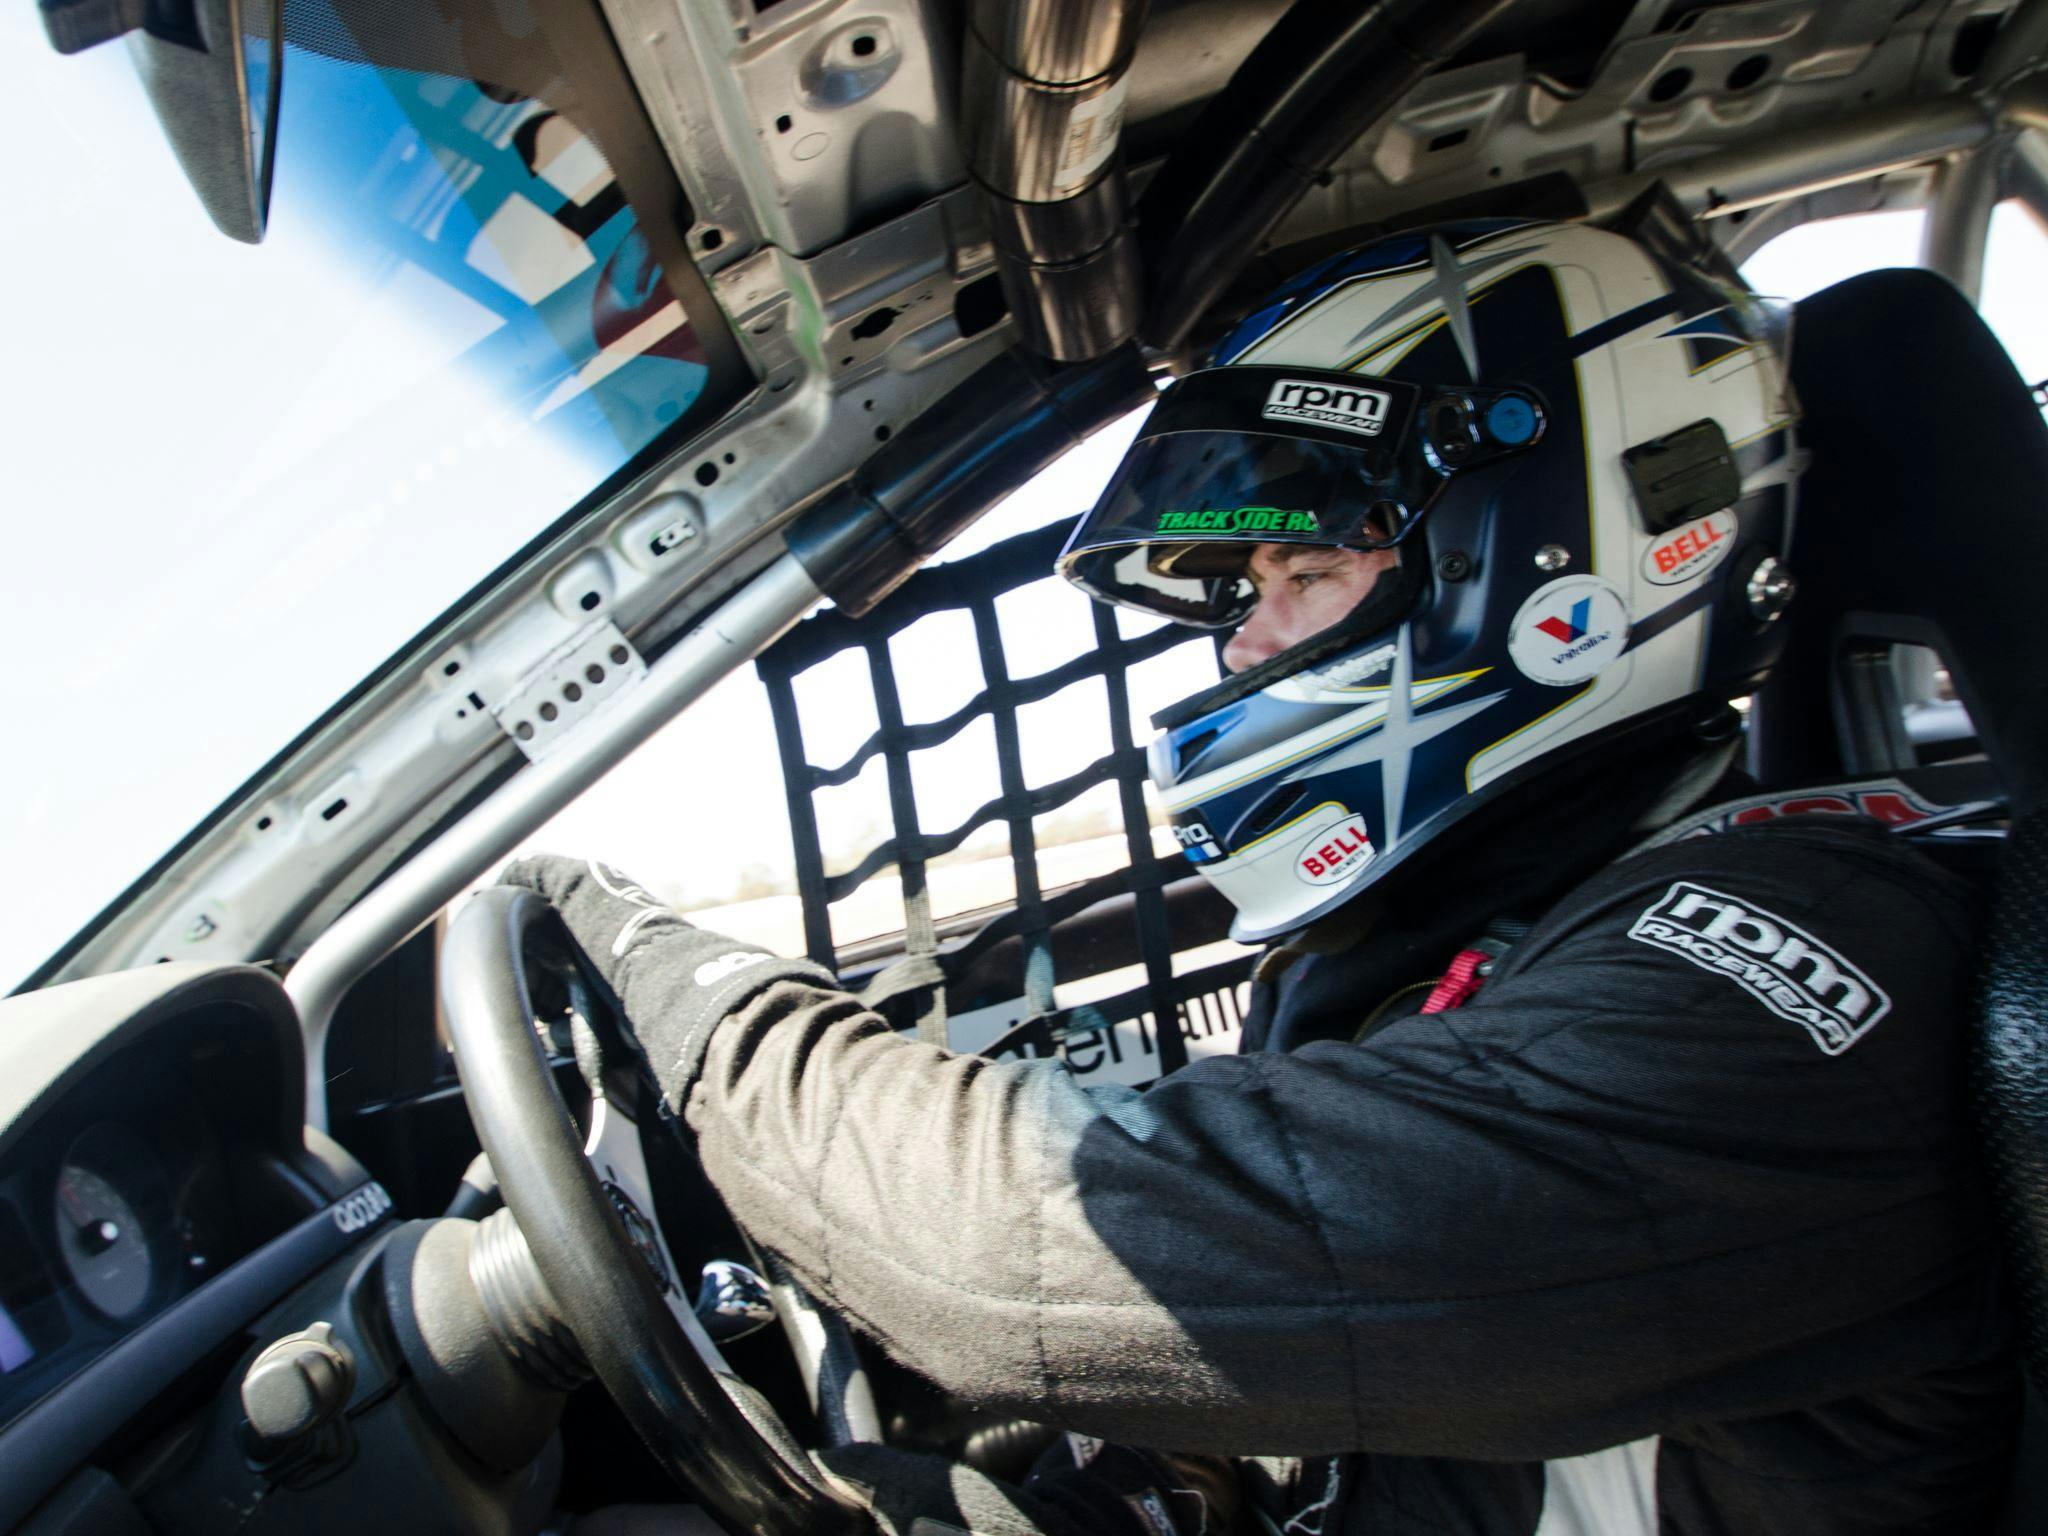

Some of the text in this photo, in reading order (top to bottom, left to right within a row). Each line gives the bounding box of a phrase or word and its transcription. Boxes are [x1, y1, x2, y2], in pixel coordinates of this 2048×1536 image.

[1265, 405, 1381, 430] RACEWEAR
[1279, 384, 1380, 417] rpm
[1653, 519, 1724, 574] BELL
[1302, 826, 1369, 878] BELL
[1668, 893, 1871, 1020] rpm
[1640, 923, 1848, 1047] RACEWEAR
